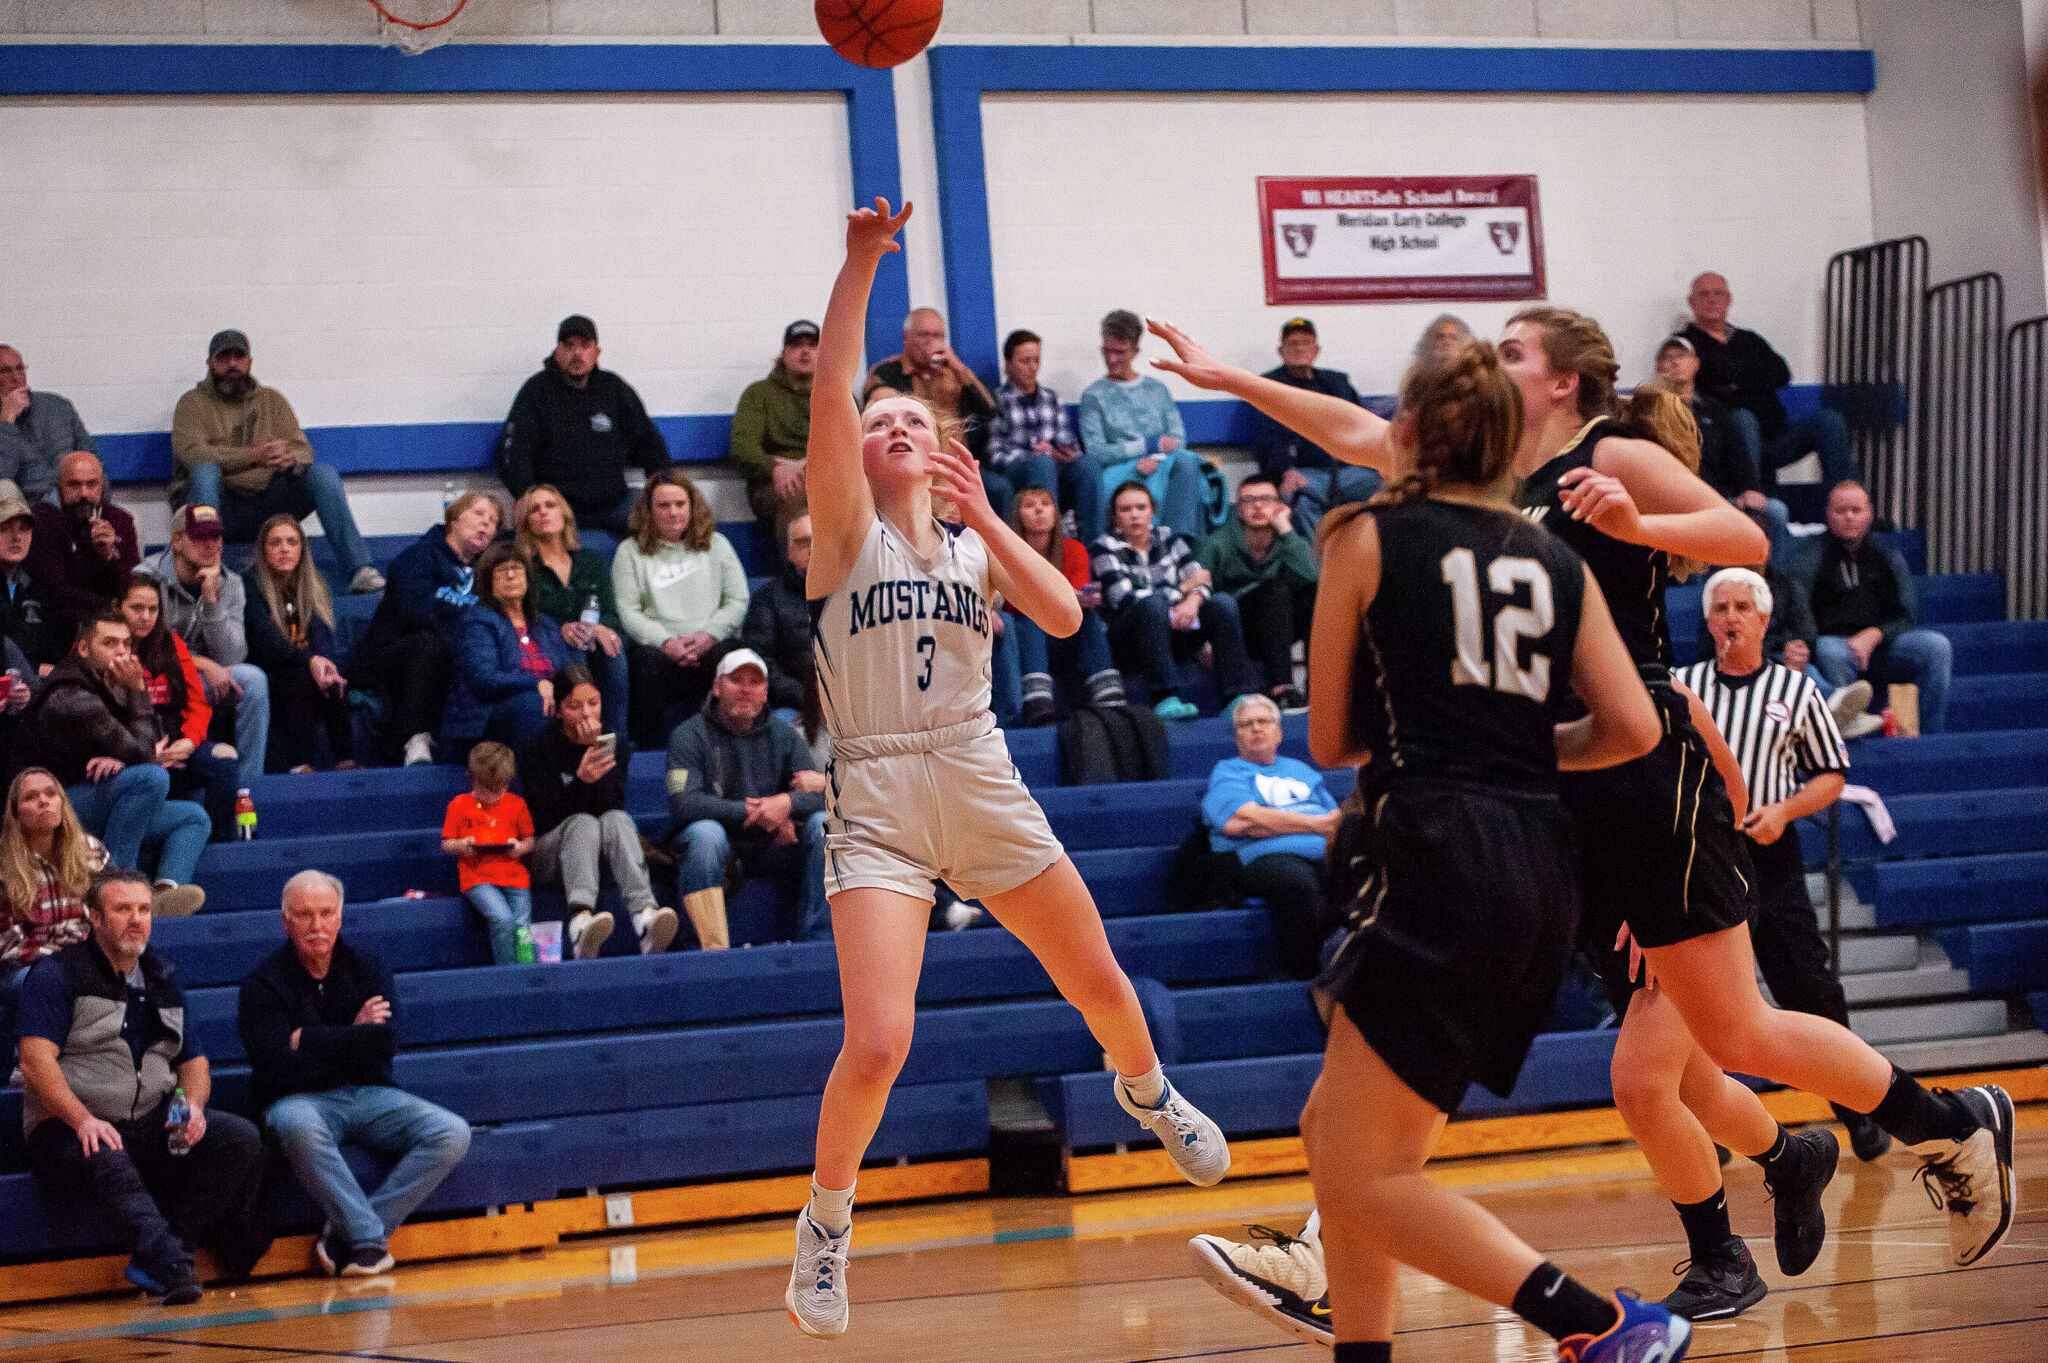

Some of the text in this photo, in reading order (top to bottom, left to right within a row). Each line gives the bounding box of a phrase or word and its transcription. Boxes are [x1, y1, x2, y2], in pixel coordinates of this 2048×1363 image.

[1369, 234, 1439, 251] High School
[1426, 212, 1466, 228] College
[850, 580, 989, 639] MUSTANGS
[1441, 547, 1554, 703] 12
[916, 635, 936, 691] 3
